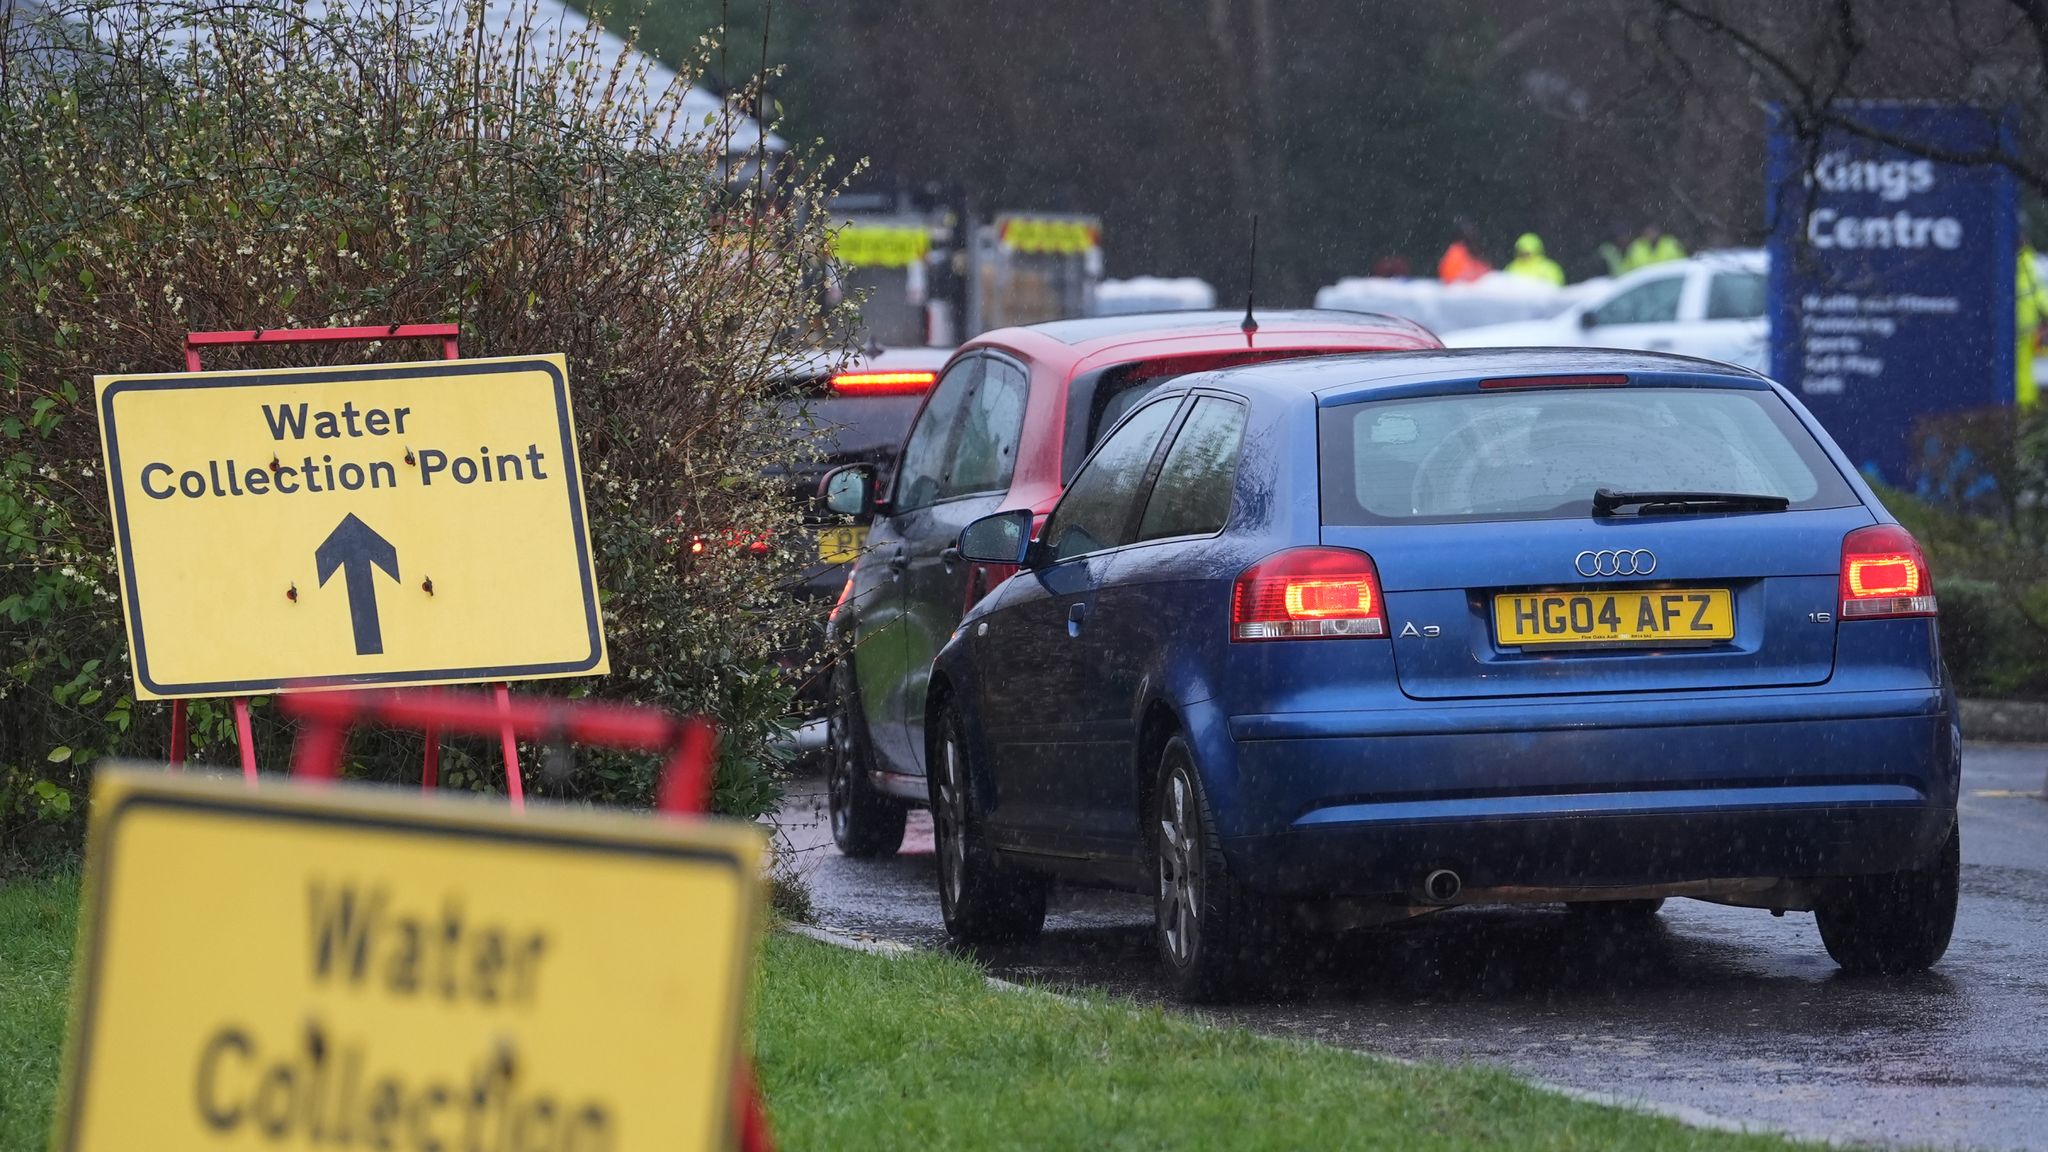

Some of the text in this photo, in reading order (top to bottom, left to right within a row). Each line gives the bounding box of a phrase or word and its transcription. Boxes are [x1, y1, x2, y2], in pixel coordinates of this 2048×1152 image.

[1807, 208, 1963, 249] Centre
[261, 401, 411, 441] Water
[140, 443, 548, 500] Collection Point
[1399, 621, 1441, 638] A3
[1514, 594, 1714, 634] HG04 AFZ
[308, 882, 550, 1001] Water
[193, 1022, 620, 1152] Collection
